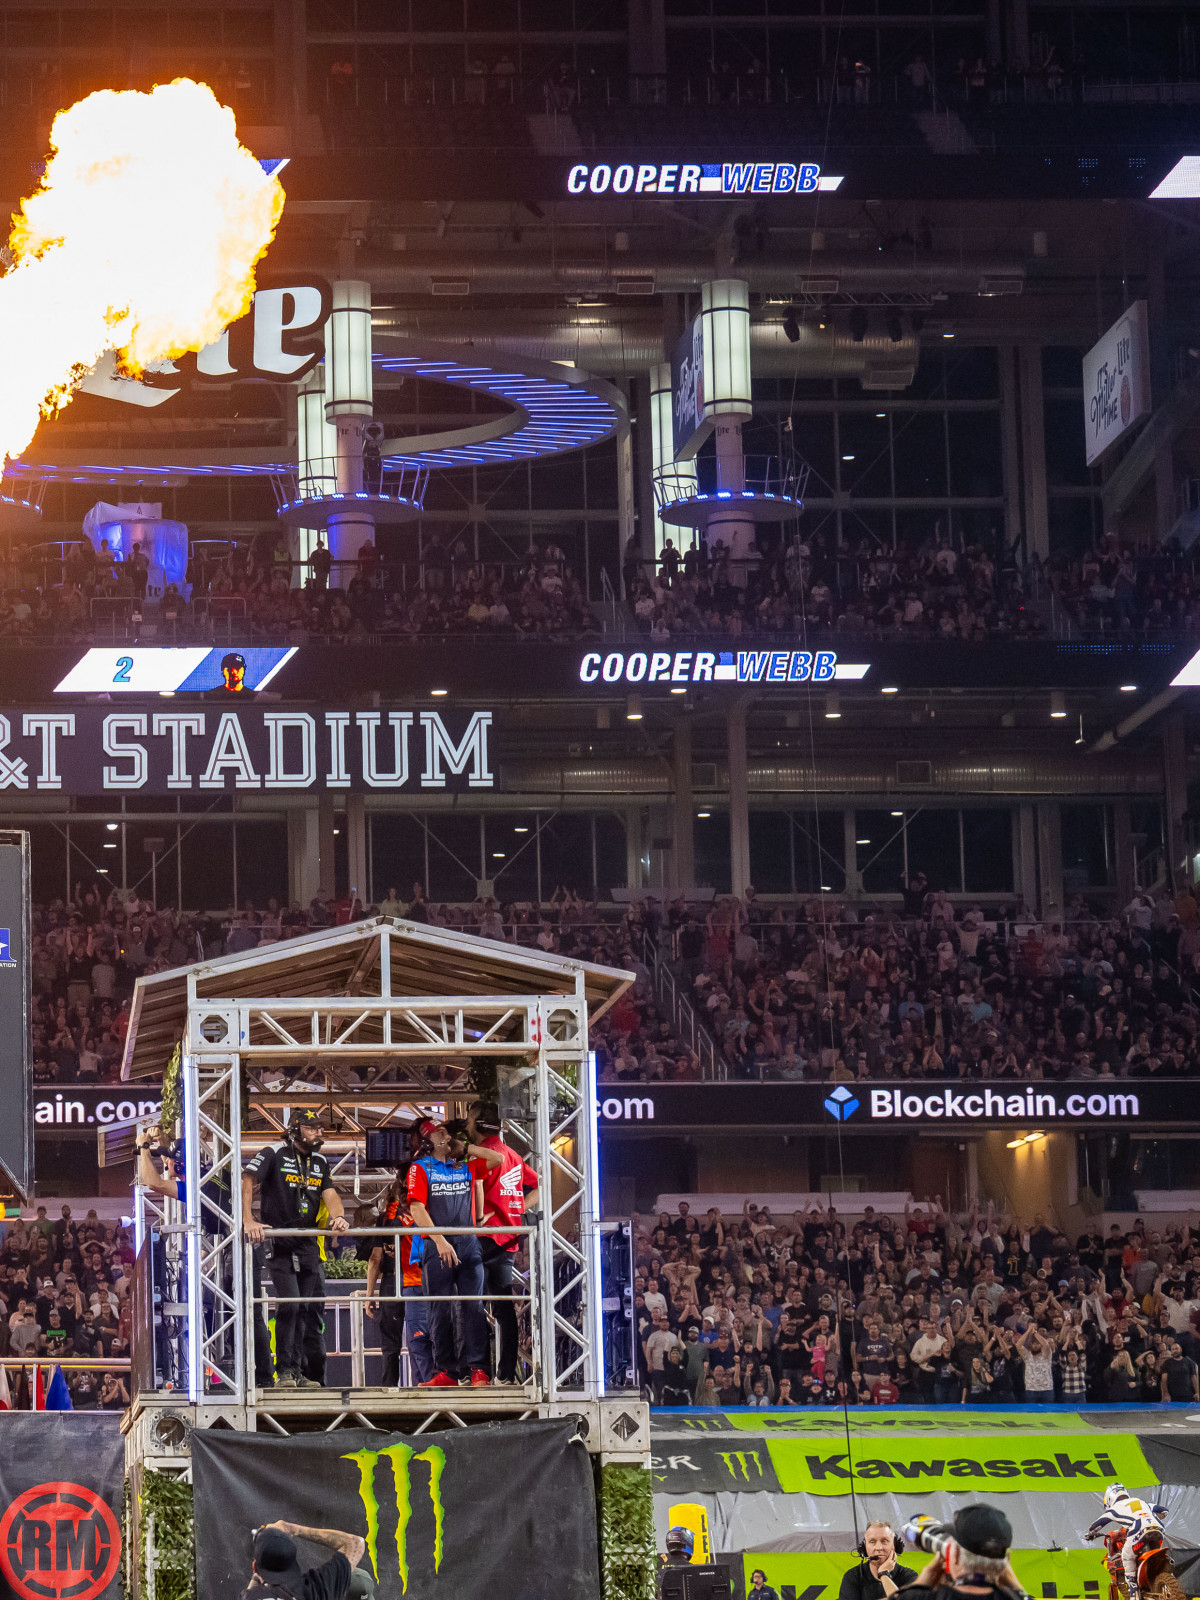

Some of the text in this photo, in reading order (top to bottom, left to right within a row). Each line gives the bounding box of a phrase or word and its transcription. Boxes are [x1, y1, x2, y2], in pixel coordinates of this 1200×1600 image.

[567, 163, 820, 193] COOPER WEBB
[1117, 336, 1131, 376] Lite
[113, 656, 134, 682] 2
[579, 651, 837, 682] COOPER WEBB
[102, 712, 495, 790] STADIUM
[870, 1087, 1140, 1118] Blockchain.com
[500, 1189, 523, 1197] HOND
[762, 1418, 1059, 1429] Kawasaki
[805, 1453, 1118, 1481] Kawasaki
[1125, 1500, 1142, 1513] 1
[19, 1519, 96, 1571] RM
